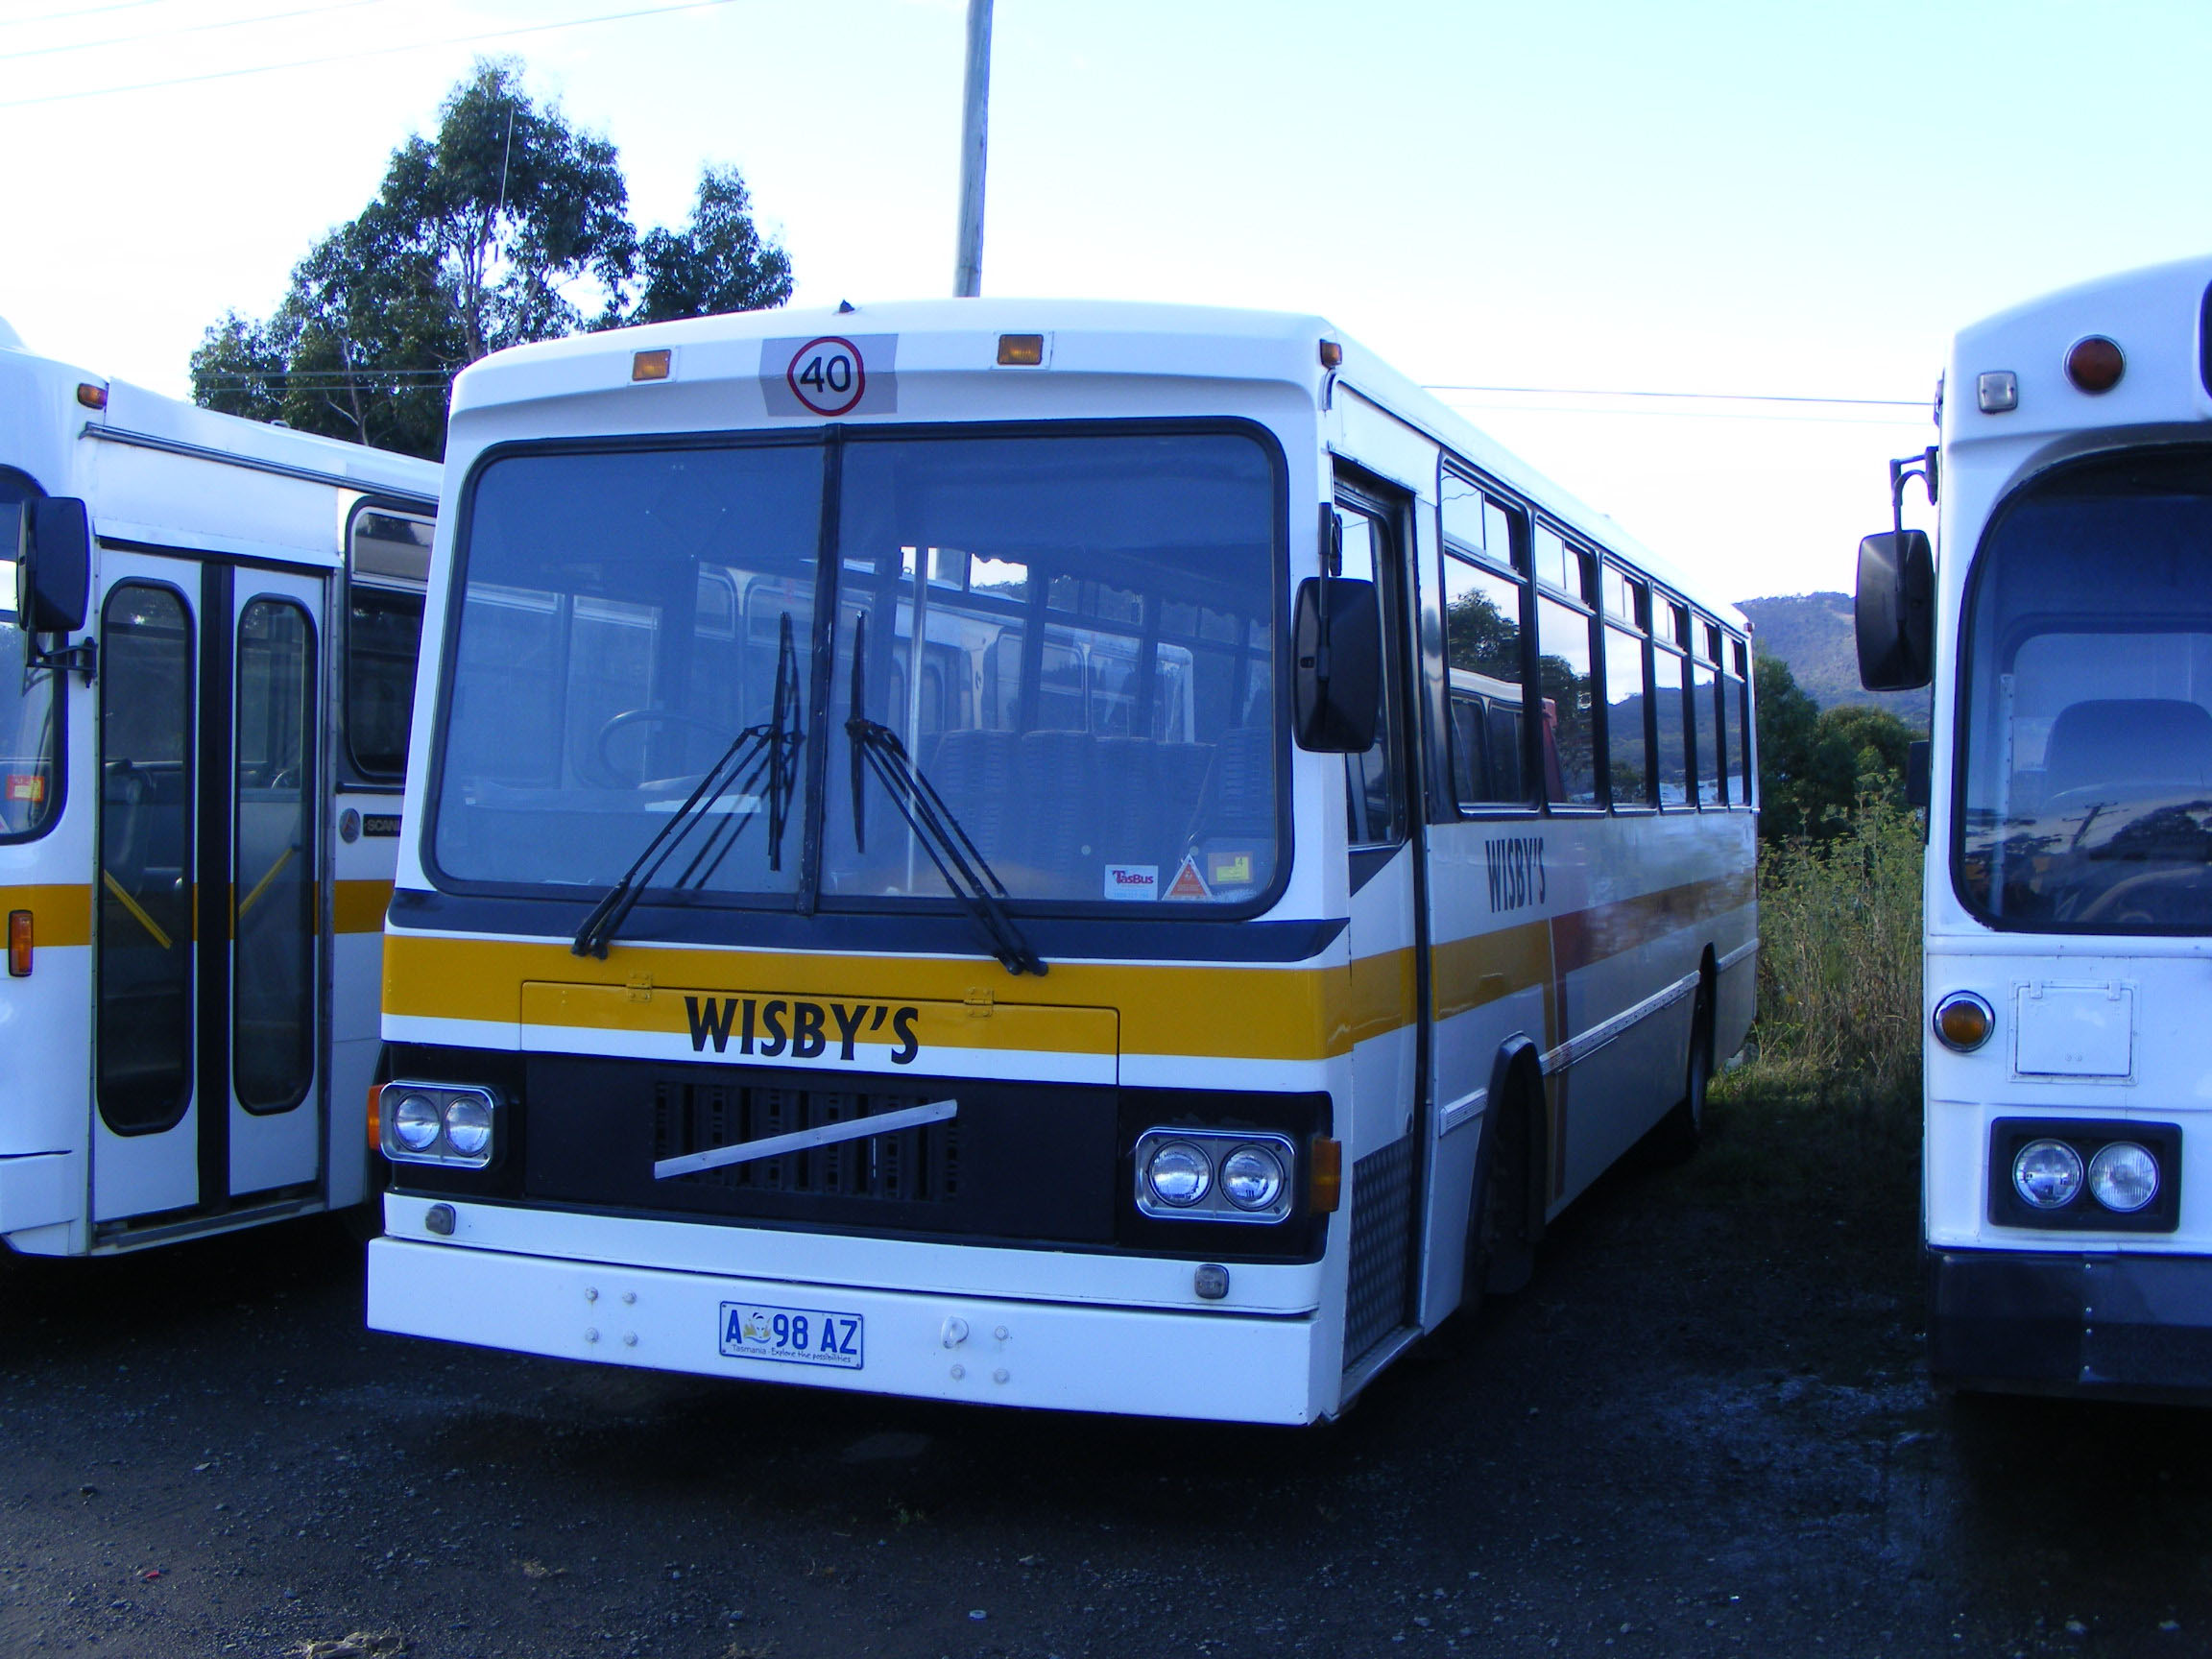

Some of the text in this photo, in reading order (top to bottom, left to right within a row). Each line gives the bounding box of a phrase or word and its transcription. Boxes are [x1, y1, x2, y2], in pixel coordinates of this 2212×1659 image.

[800, 355, 852, 394] 40
[1112, 870, 1154, 885] TasBus
[1484, 836, 1546, 913] WISBY'S
[684, 996, 919, 1065] WISBY'S
[725, 1310, 857, 1355] A 98 AZ
[732, 1344, 766, 1355] Tasmania
[771, 1347, 796, 1359] Explore
[812, 1353, 852, 1363] possibilities
